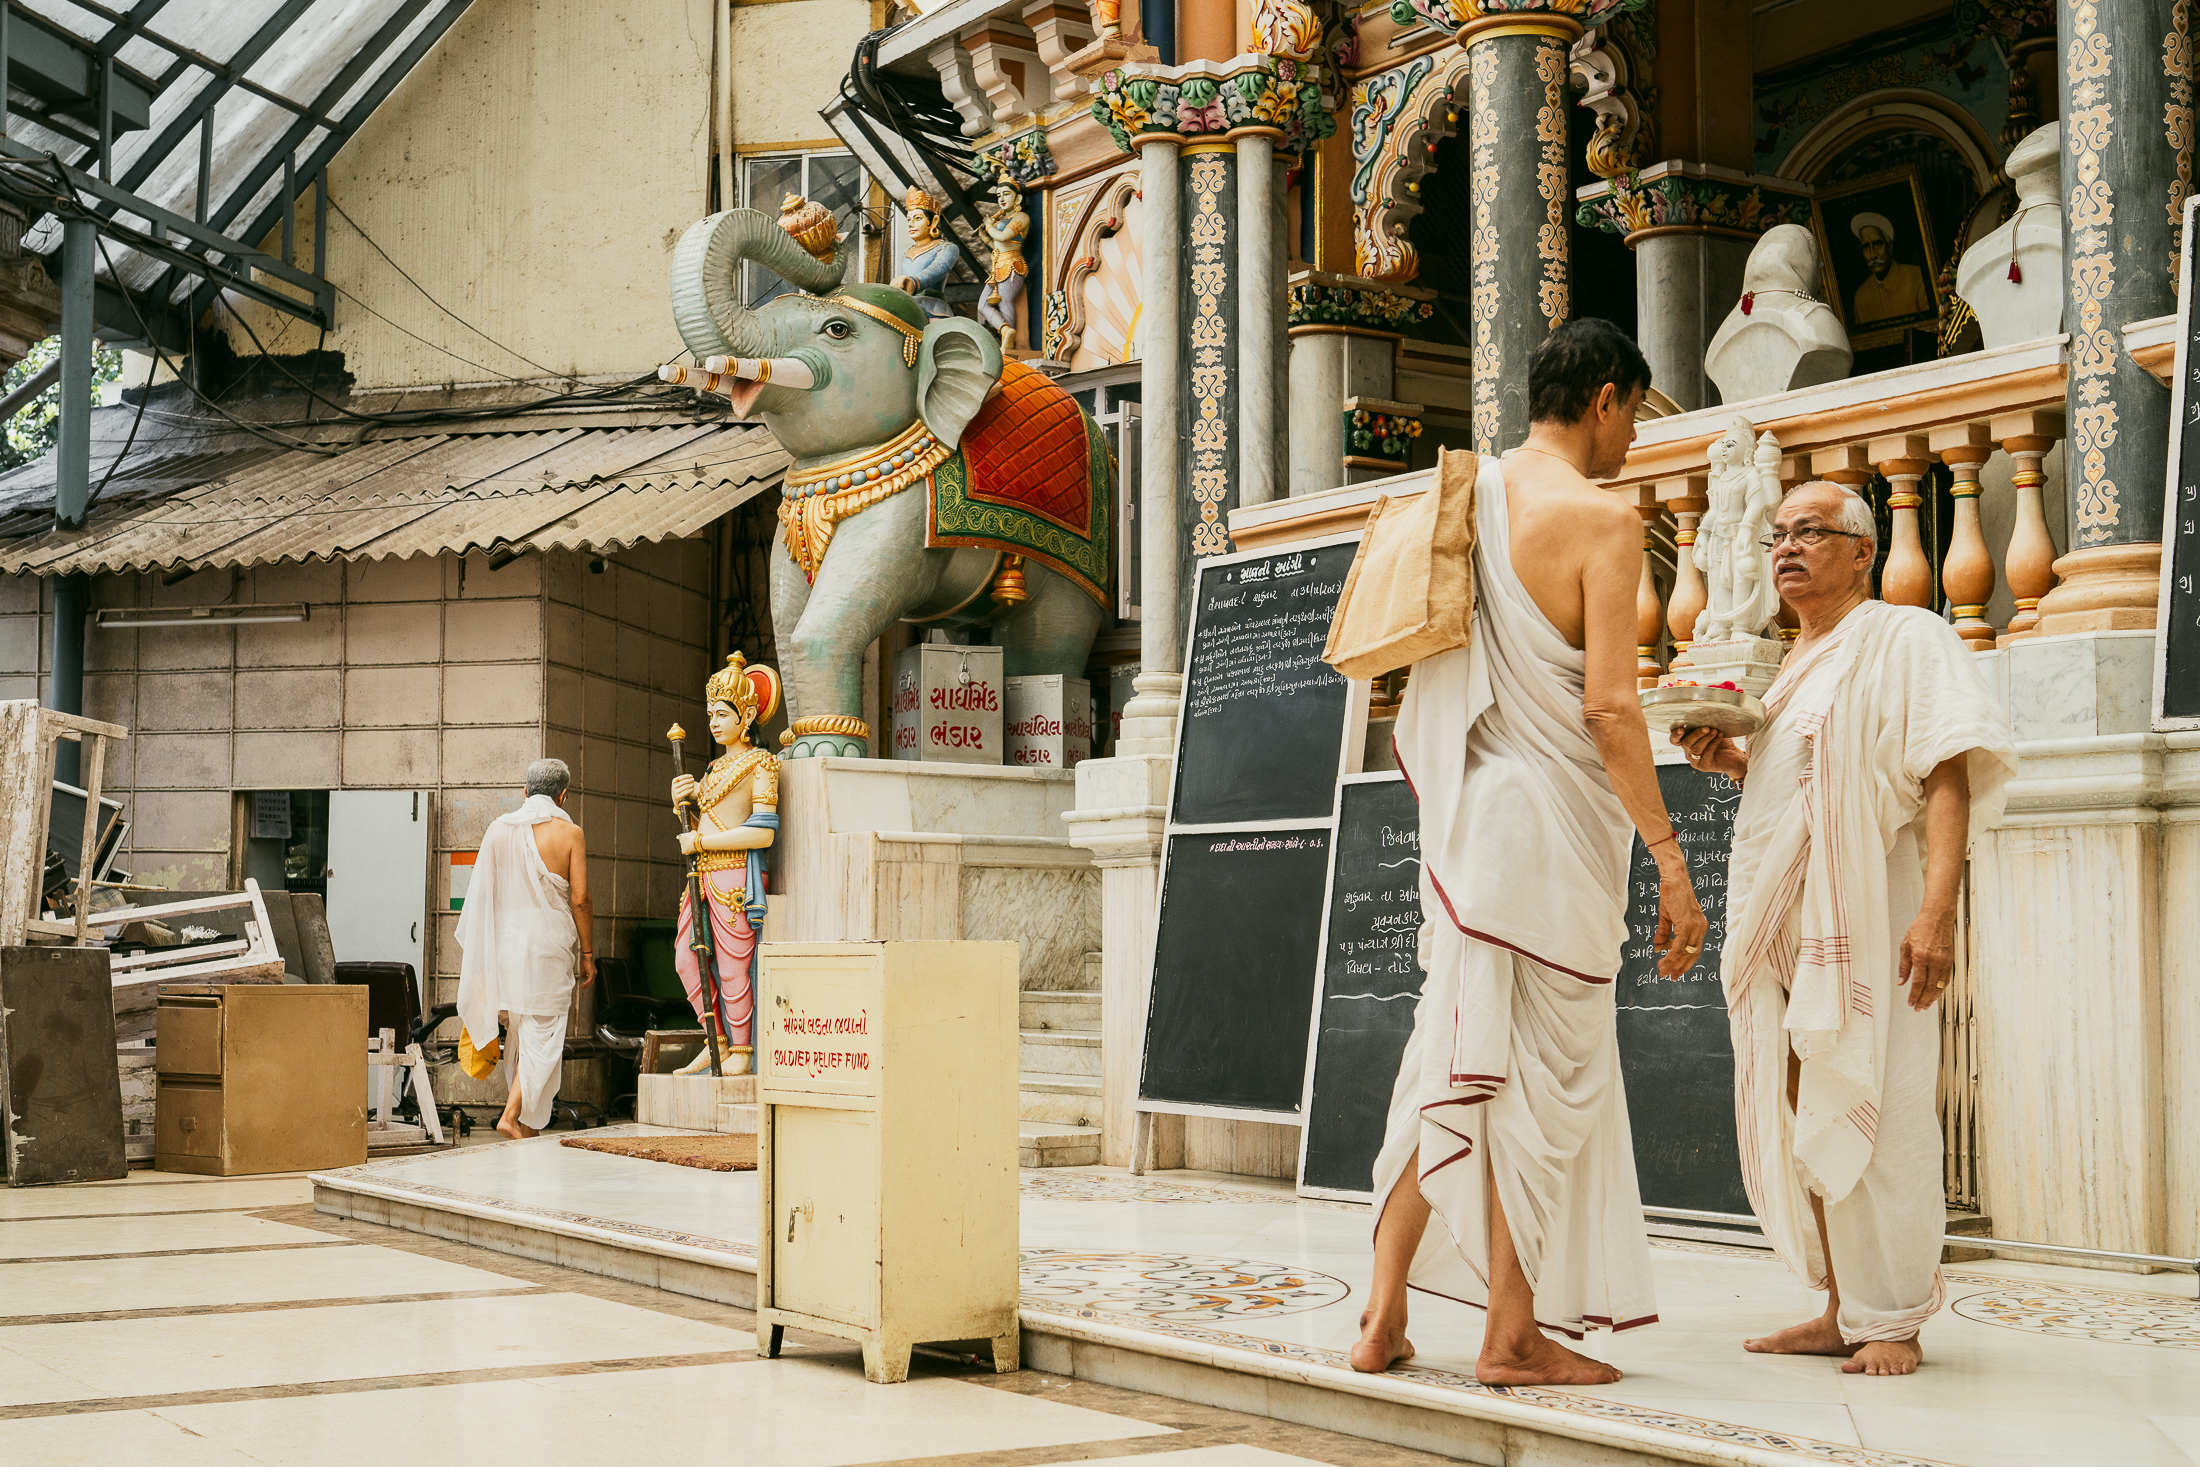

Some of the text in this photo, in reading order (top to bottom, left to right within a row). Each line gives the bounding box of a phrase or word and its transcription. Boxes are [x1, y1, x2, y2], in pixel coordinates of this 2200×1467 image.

[930, 681, 999, 712] સાધર્મિક
[895, 723, 917, 750] ભંડાર
[930, 720, 983, 750] ભંડાર
[1007, 714, 1062, 737] આયંબિલ
[1014, 745, 1052, 766] ભંડાર
[807, 1018, 832, 1036] લડતા
[834, 1008, 868, 1035] જવાનો
[774, 1049, 870, 1078] SOLDIER RELIEF FUND
